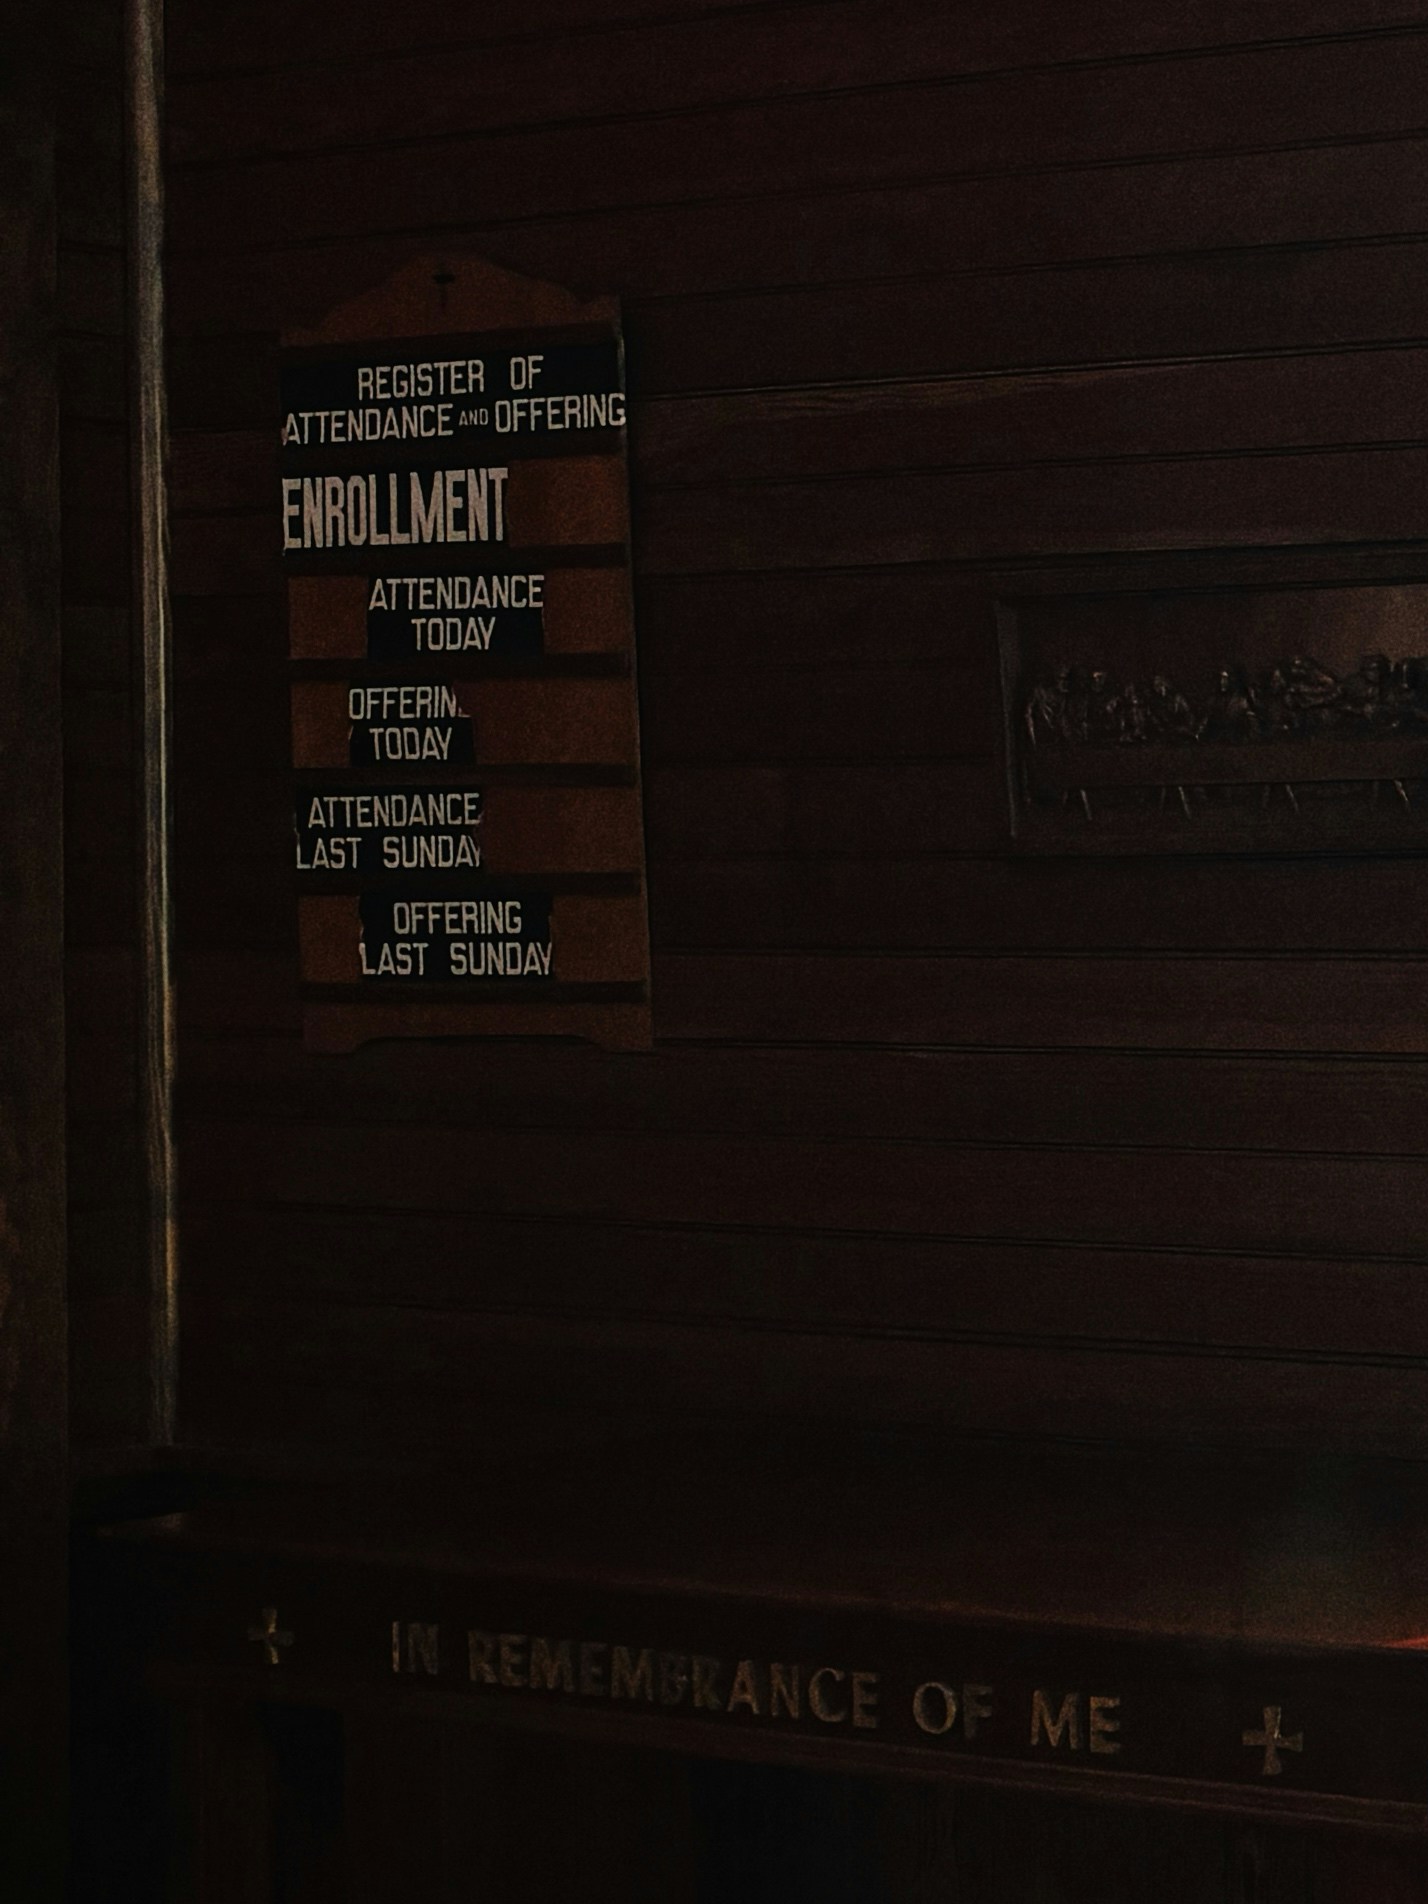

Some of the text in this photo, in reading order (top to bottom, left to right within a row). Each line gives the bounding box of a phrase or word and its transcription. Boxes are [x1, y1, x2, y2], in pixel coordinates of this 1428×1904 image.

[358, 354, 545, 401] REGISTER OF
[281, 392, 626, 446] ATTENDANCE AND OFFERING
[281, 467, 509, 550] ENROLLMENT
[368, 574, 545, 611] ATTENDANCE
[411, 616, 496, 652] TODAY
[348, 685, 472, 720] OFFERIN
[368, 726, 453, 762] TODAY
[308, 792, 481, 829] ATTENDANCE
[295, 836, 362, 870] LAST
[393, 901, 522, 935] OFFERING
[359, 941, 553, 977] LAST SUNDAY
[391, 1620, 1122, 1754] IN REMEMBRANCE OF ME
